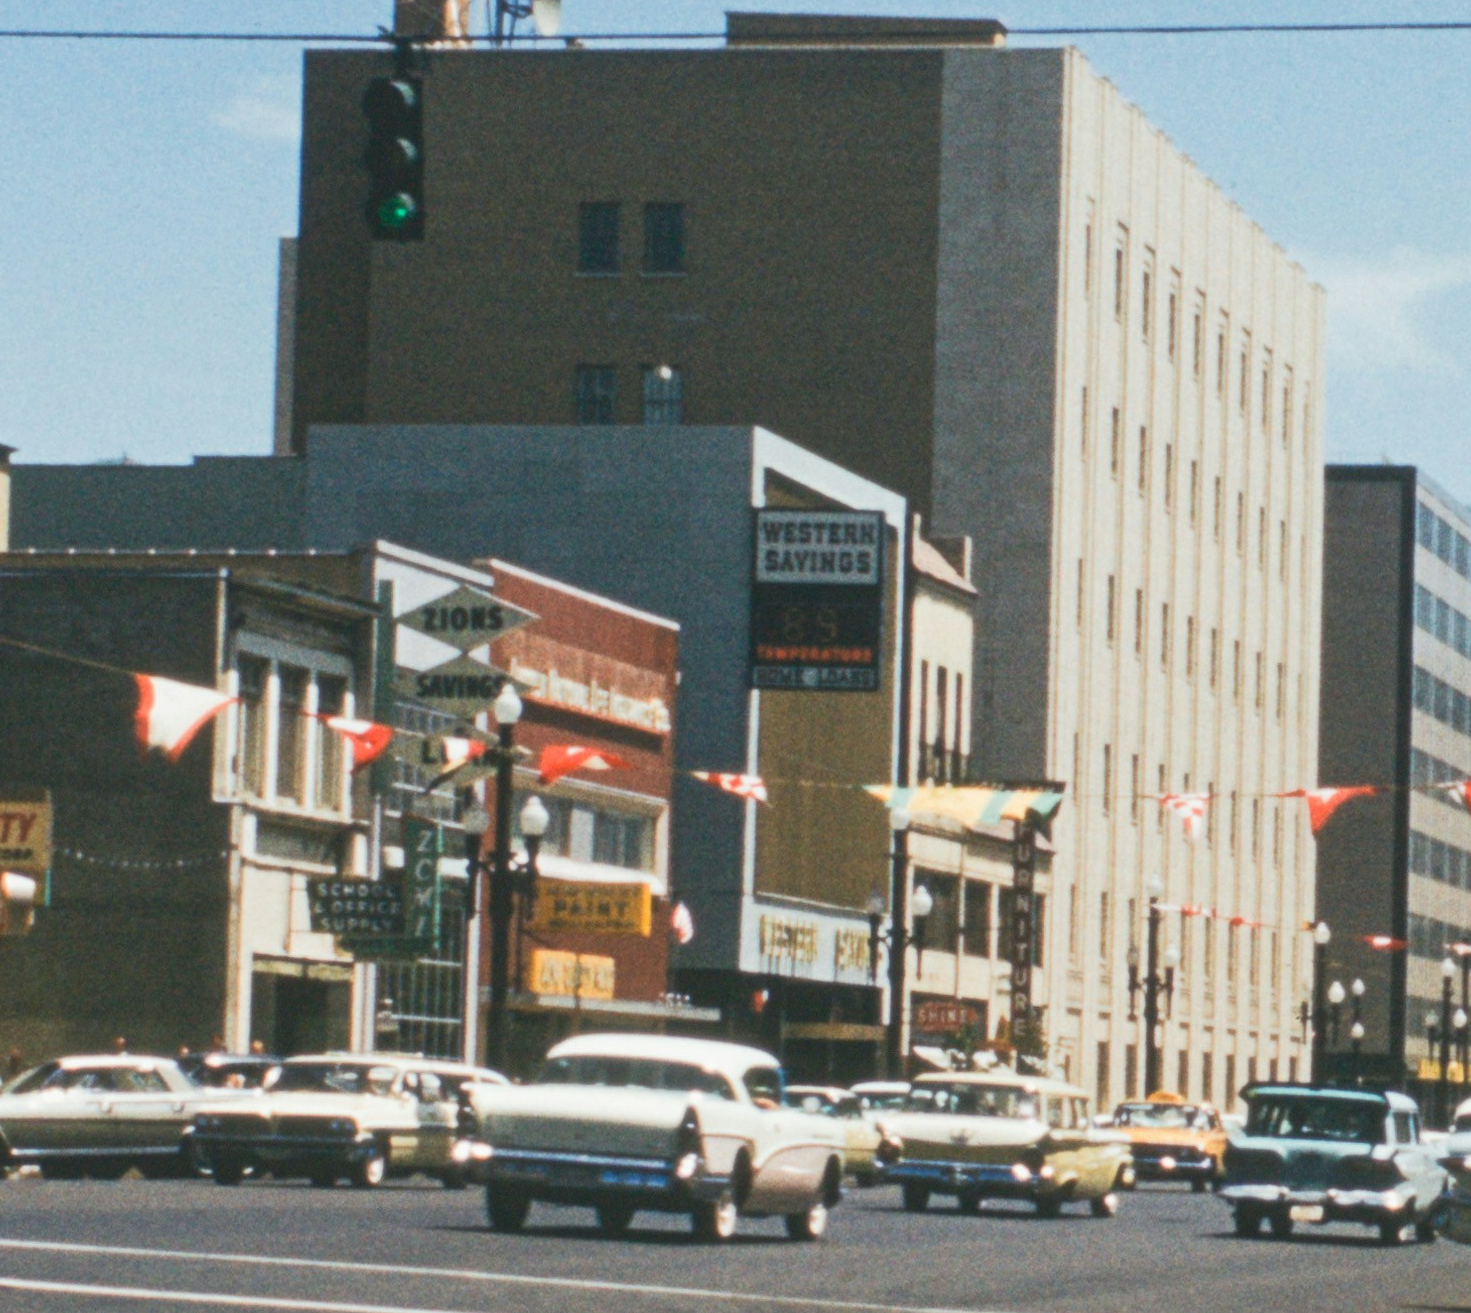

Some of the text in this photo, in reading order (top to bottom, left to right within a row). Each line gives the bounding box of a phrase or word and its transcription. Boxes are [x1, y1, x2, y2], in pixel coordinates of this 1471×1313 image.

[763, 521, 876, 545] WESTERN
[765, 550, 871, 574] SAVINGS
[423, 606, 504, 631] ZIONS
[757, 643, 873, 664] TEMPERATURE
[317, 882, 398, 898] SCHOOL
[415, 829, 434, 938] ZCMI
[331, 899, 404, 916] OFFICE
[319, 917, 394, 932] SUPPLY
[1014, 819, 1031, 1037] FURNITURE
